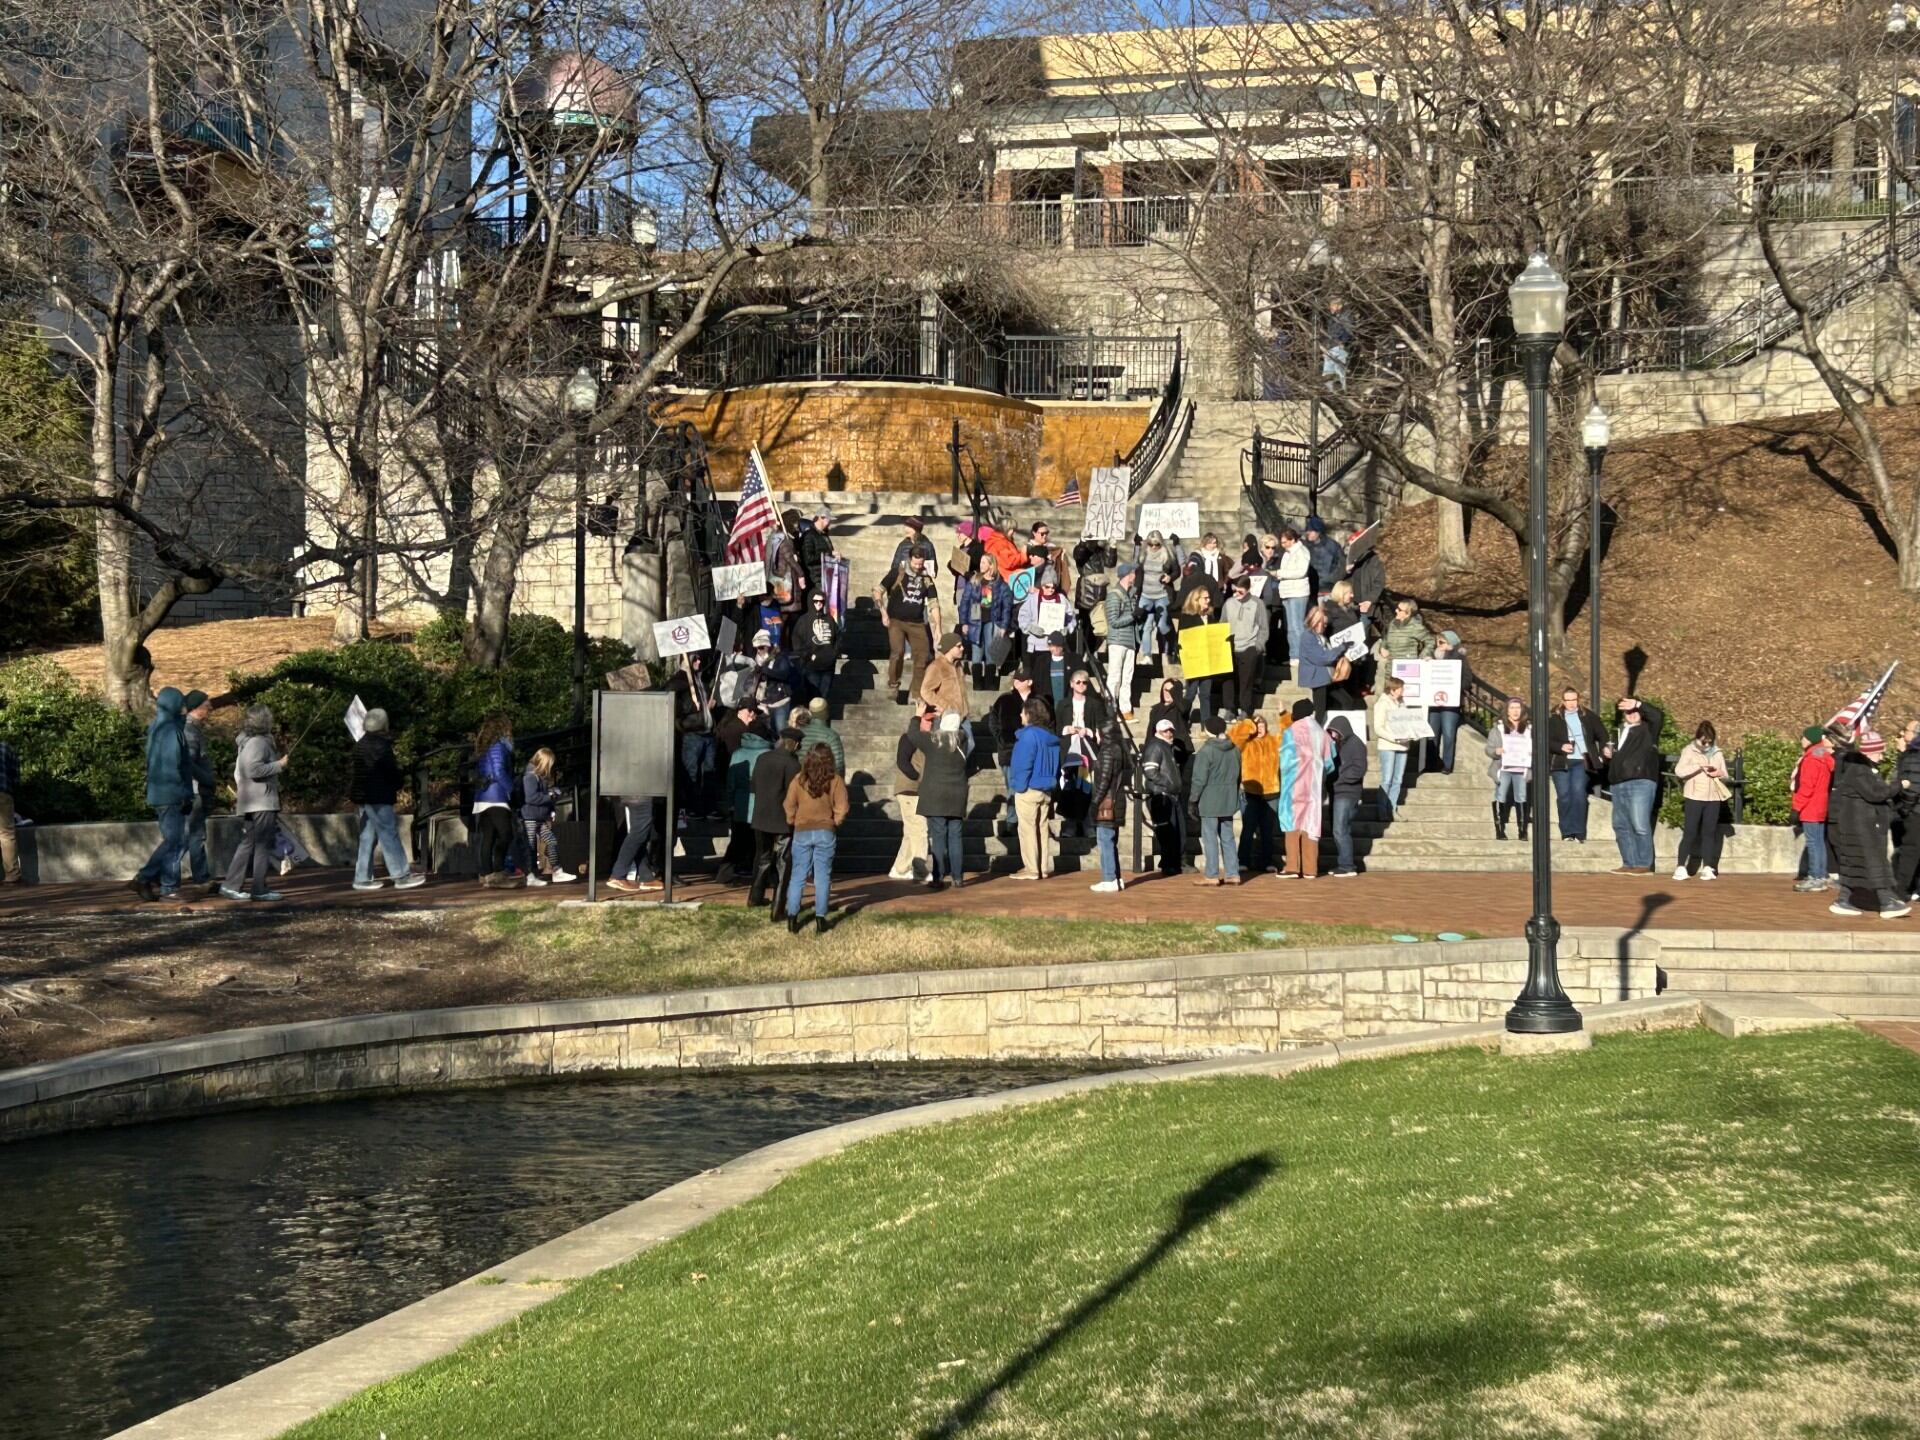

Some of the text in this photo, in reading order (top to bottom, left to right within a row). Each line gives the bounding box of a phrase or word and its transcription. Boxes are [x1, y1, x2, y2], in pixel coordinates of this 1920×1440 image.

[1096, 467, 1120, 485] US
[1092, 484, 1126, 504] AID
[1086, 502, 1125, 521] SAVES
[1086, 519, 1125, 538] LIVES
